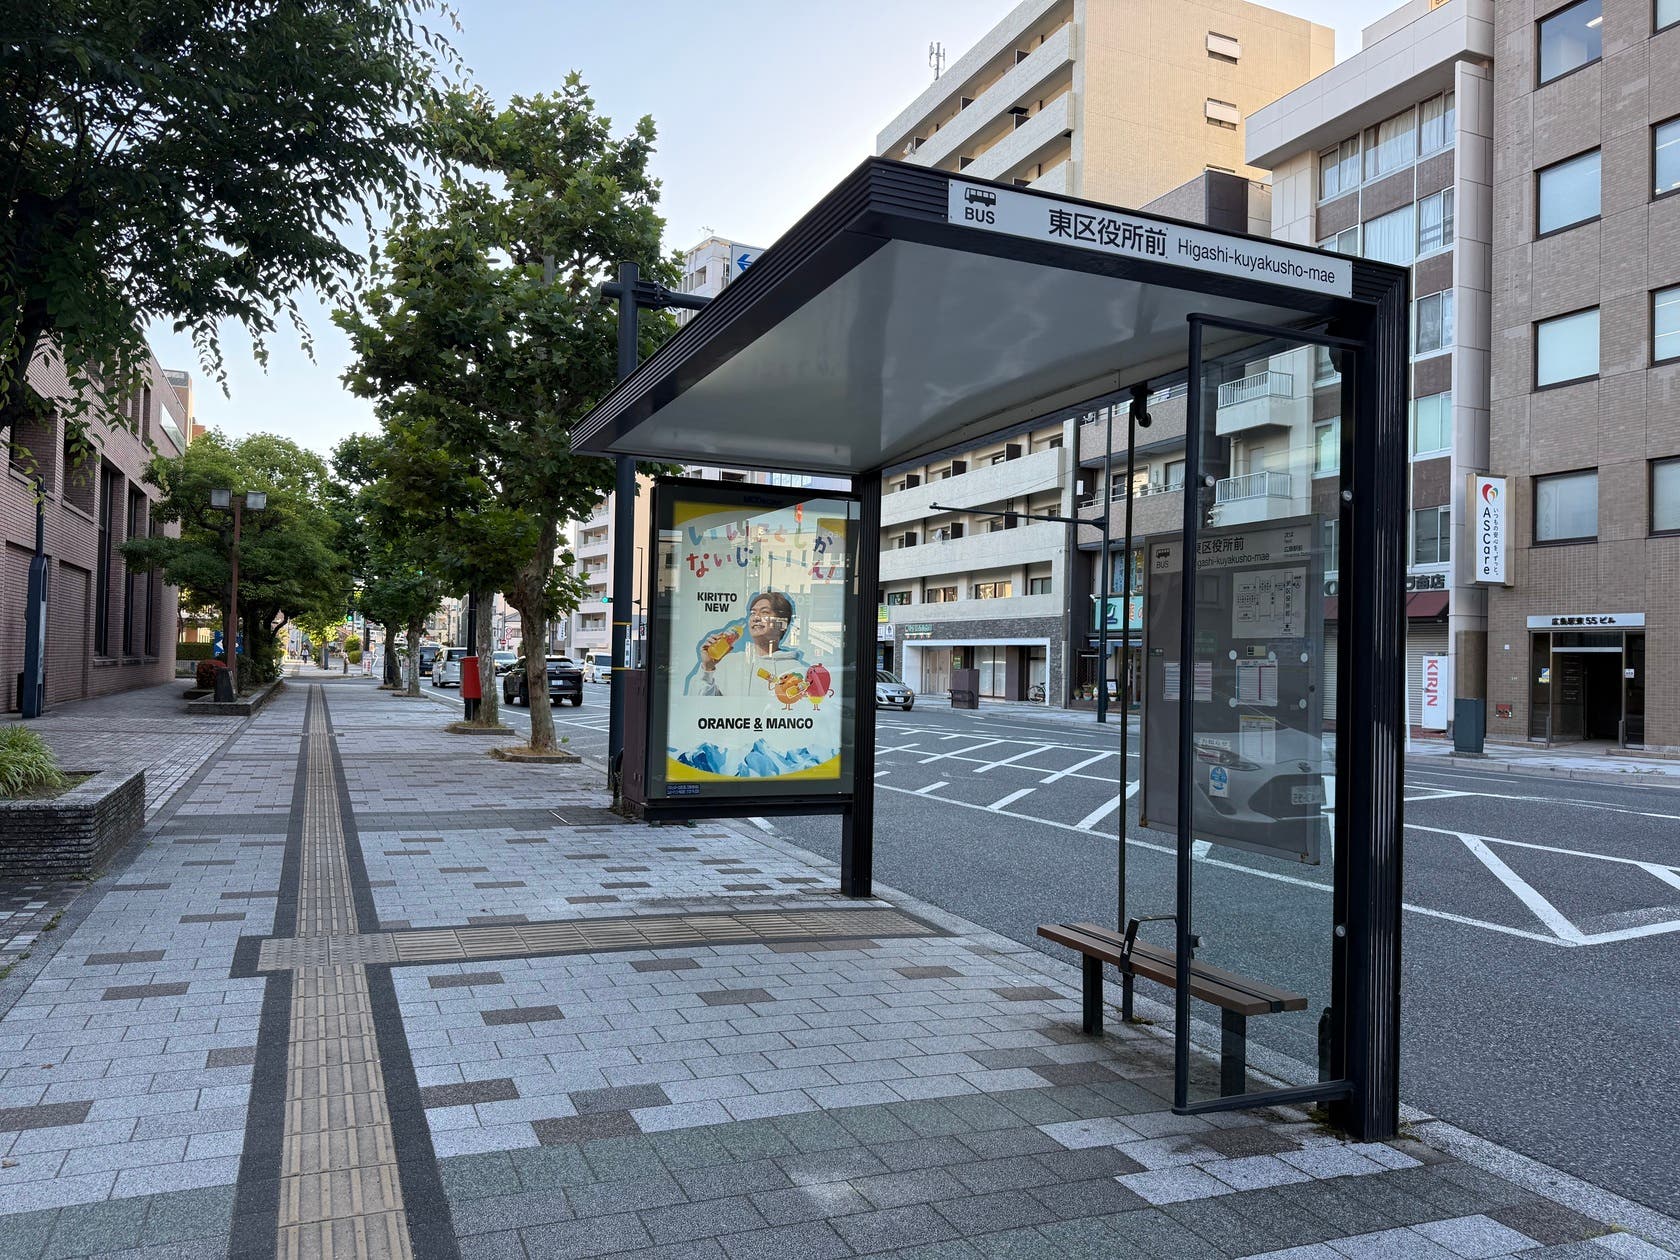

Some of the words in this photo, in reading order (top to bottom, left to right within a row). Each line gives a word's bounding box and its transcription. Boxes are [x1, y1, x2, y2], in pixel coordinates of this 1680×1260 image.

[964, 206, 995, 225] BUS
[1048, 209, 1167, 257] 東区役所前
[1178, 239, 1335, 284] Higashi-kuyakusho-mae
[1156, 561, 1169, 569] BUS
[697, 592, 737, 603] KIRITTO
[704, 603, 730, 613] NEW
[1427, 659, 1438, 707] KIRIN
[698, 717, 751, 729] ORANGE
[753, 717, 763, 732] &
[766, 717, 814, 729] MANGO
